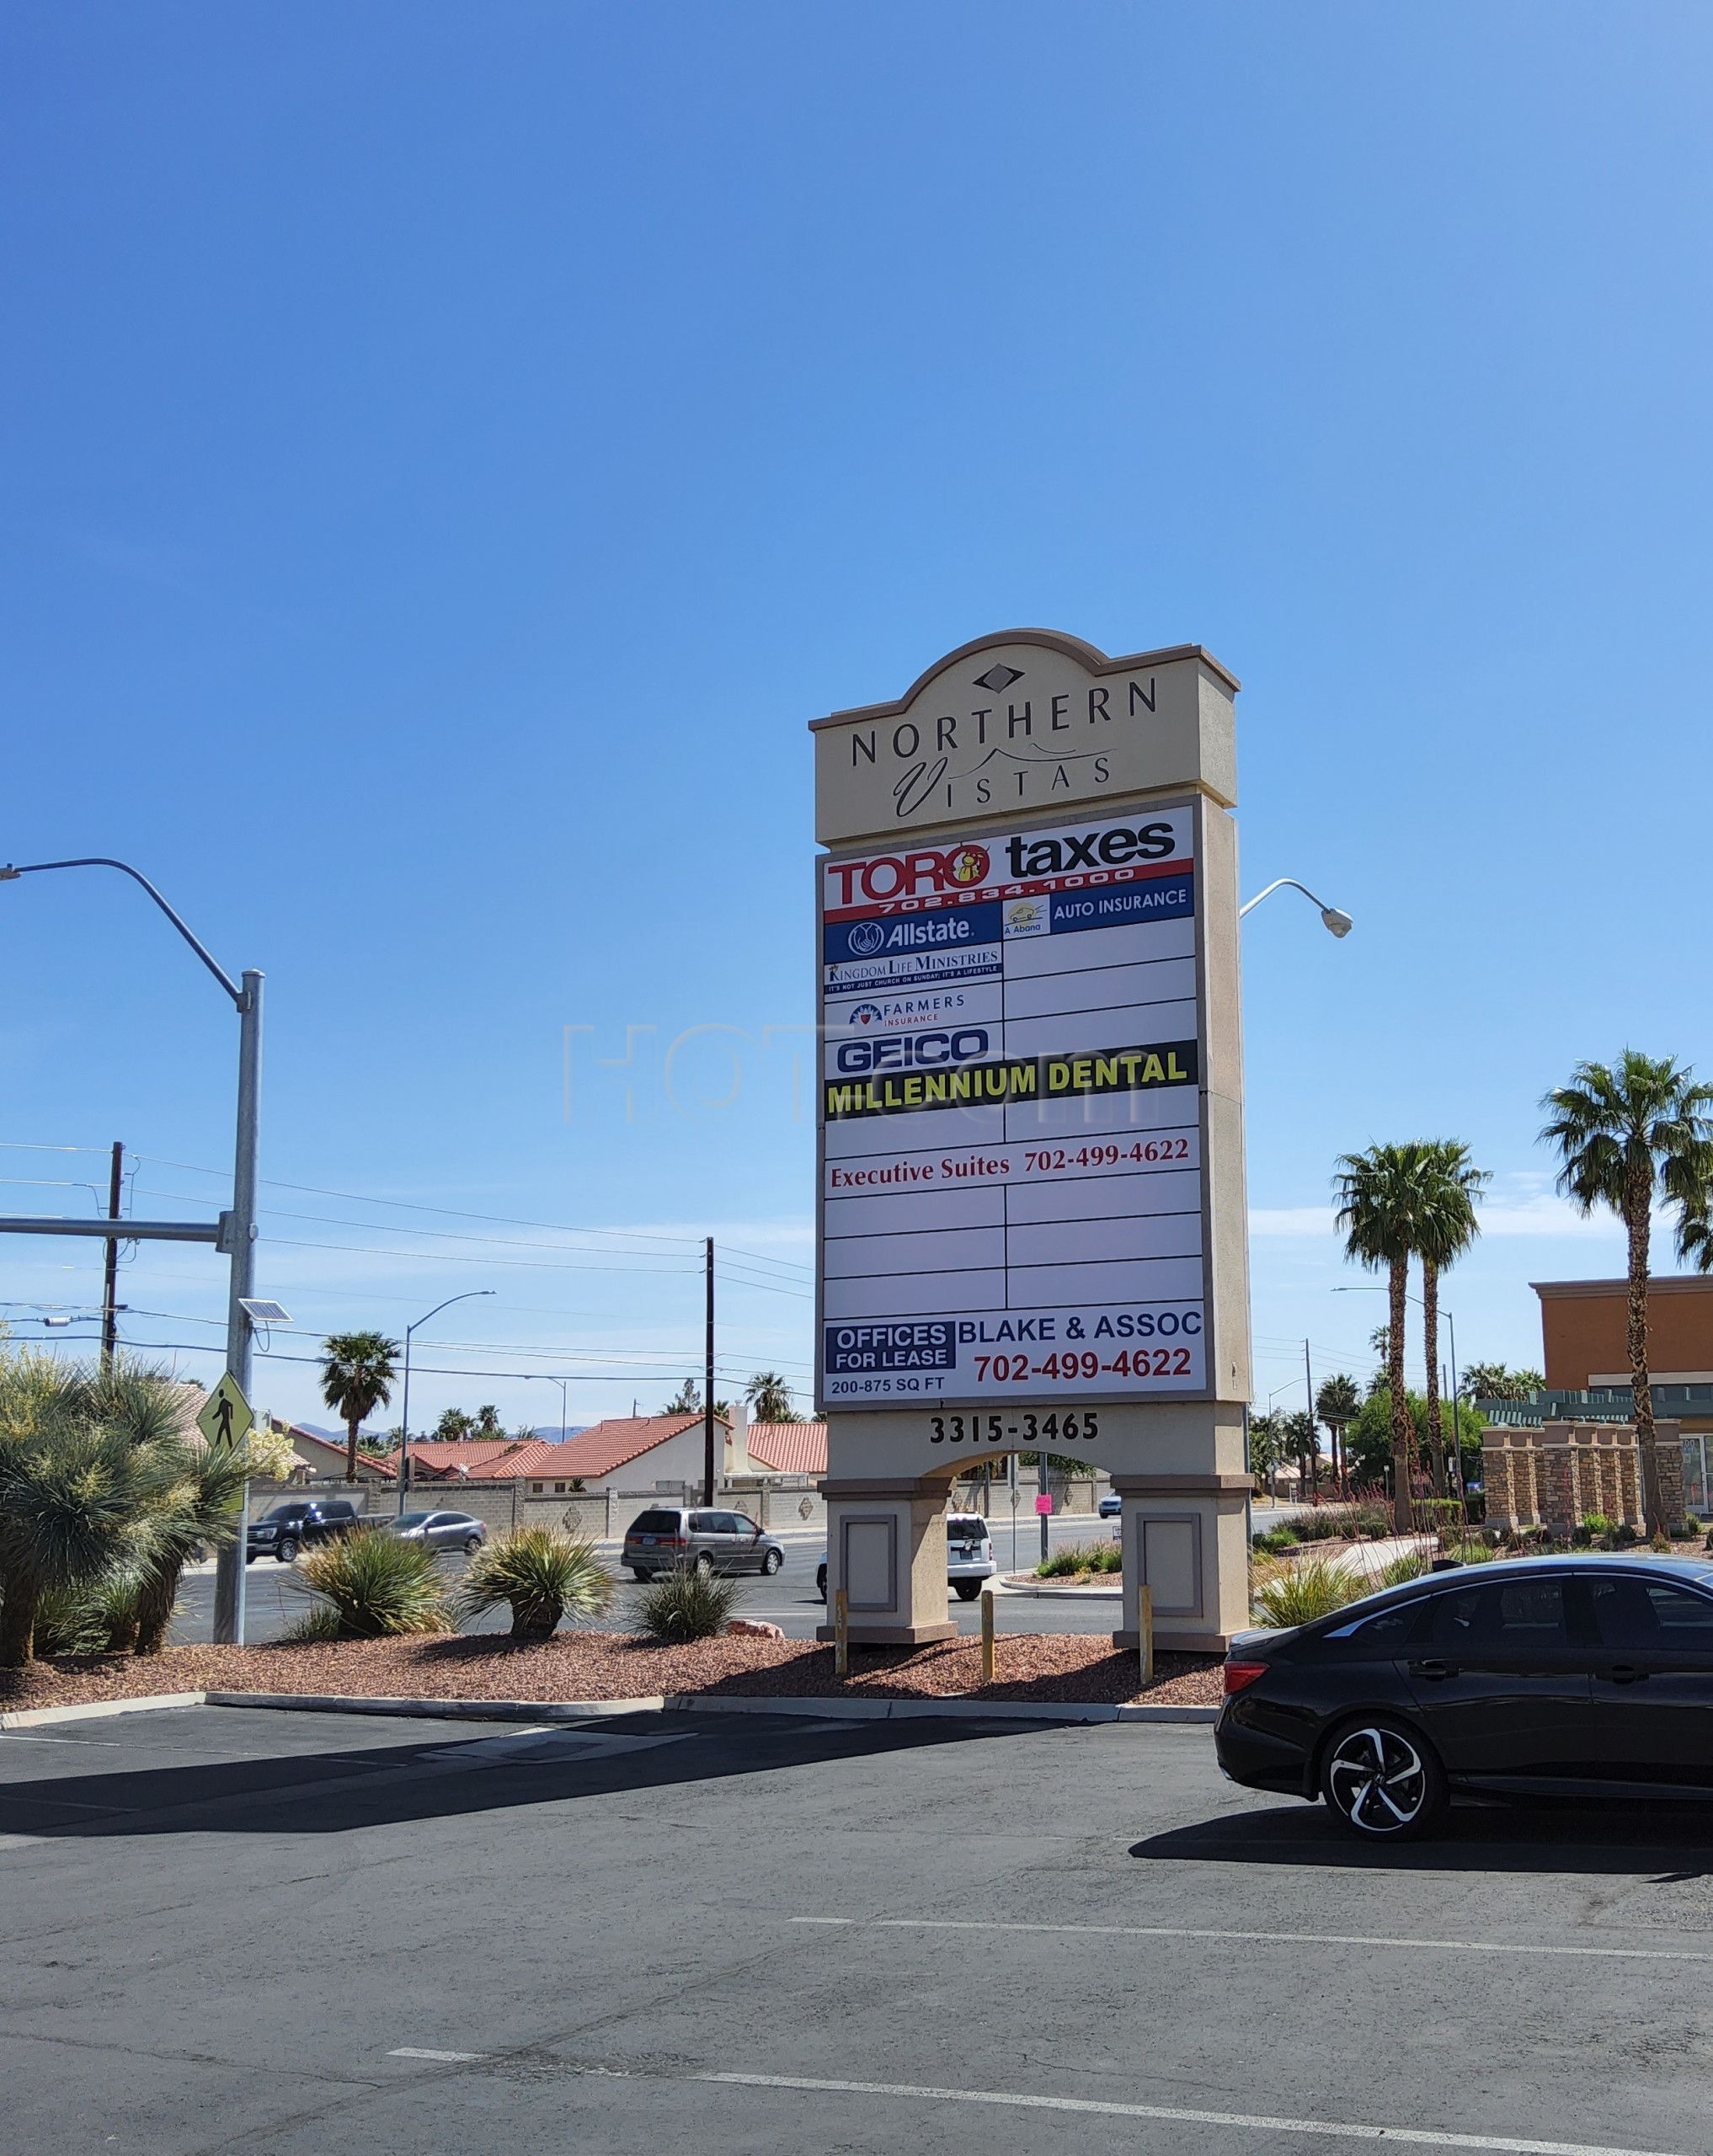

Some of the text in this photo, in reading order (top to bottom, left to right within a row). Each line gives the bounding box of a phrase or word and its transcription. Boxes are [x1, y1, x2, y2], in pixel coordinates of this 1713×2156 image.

[852, 677, 1156, 766] NORTHERN
[894, 757, 1110, 818] VISTAS
[828, 822, 1175, 905] TORO taxes
[878, 868, 1134, 915] 702.834.1000
[1054, 889, 1187, 920] AUTO INSURANCE
[830, 951, 998, 982] KINGDOM LIFE MINISTRIES
[874, 978, 900, 986] CHURCH
[963, 965, 998, 975] LIFESTYLE
[884, 995, 964, 1016] FARMERS
[884, 1013, 938, 1027] INSURANCE
[836, 1029, 989, 1073] GEICO
[828, 1051, 1187, 1114] MILLENNIUM DENTAL
[830, 1138, 1189, 1187] Executive Suites 702-499-4622
[836, 1324, 947, 1348] OFFICES
[959, 1311, 1202, 1344] BLAKE & ASSOC
[835, 1349, 947, 1369] FOR LEASE
[974, 1348, 1192, 1382] 702-499-4622
[831, 1377, 945, 1394] 200-875 SQ FT
[930, 1412, 1099, 1444] 3315-3465
